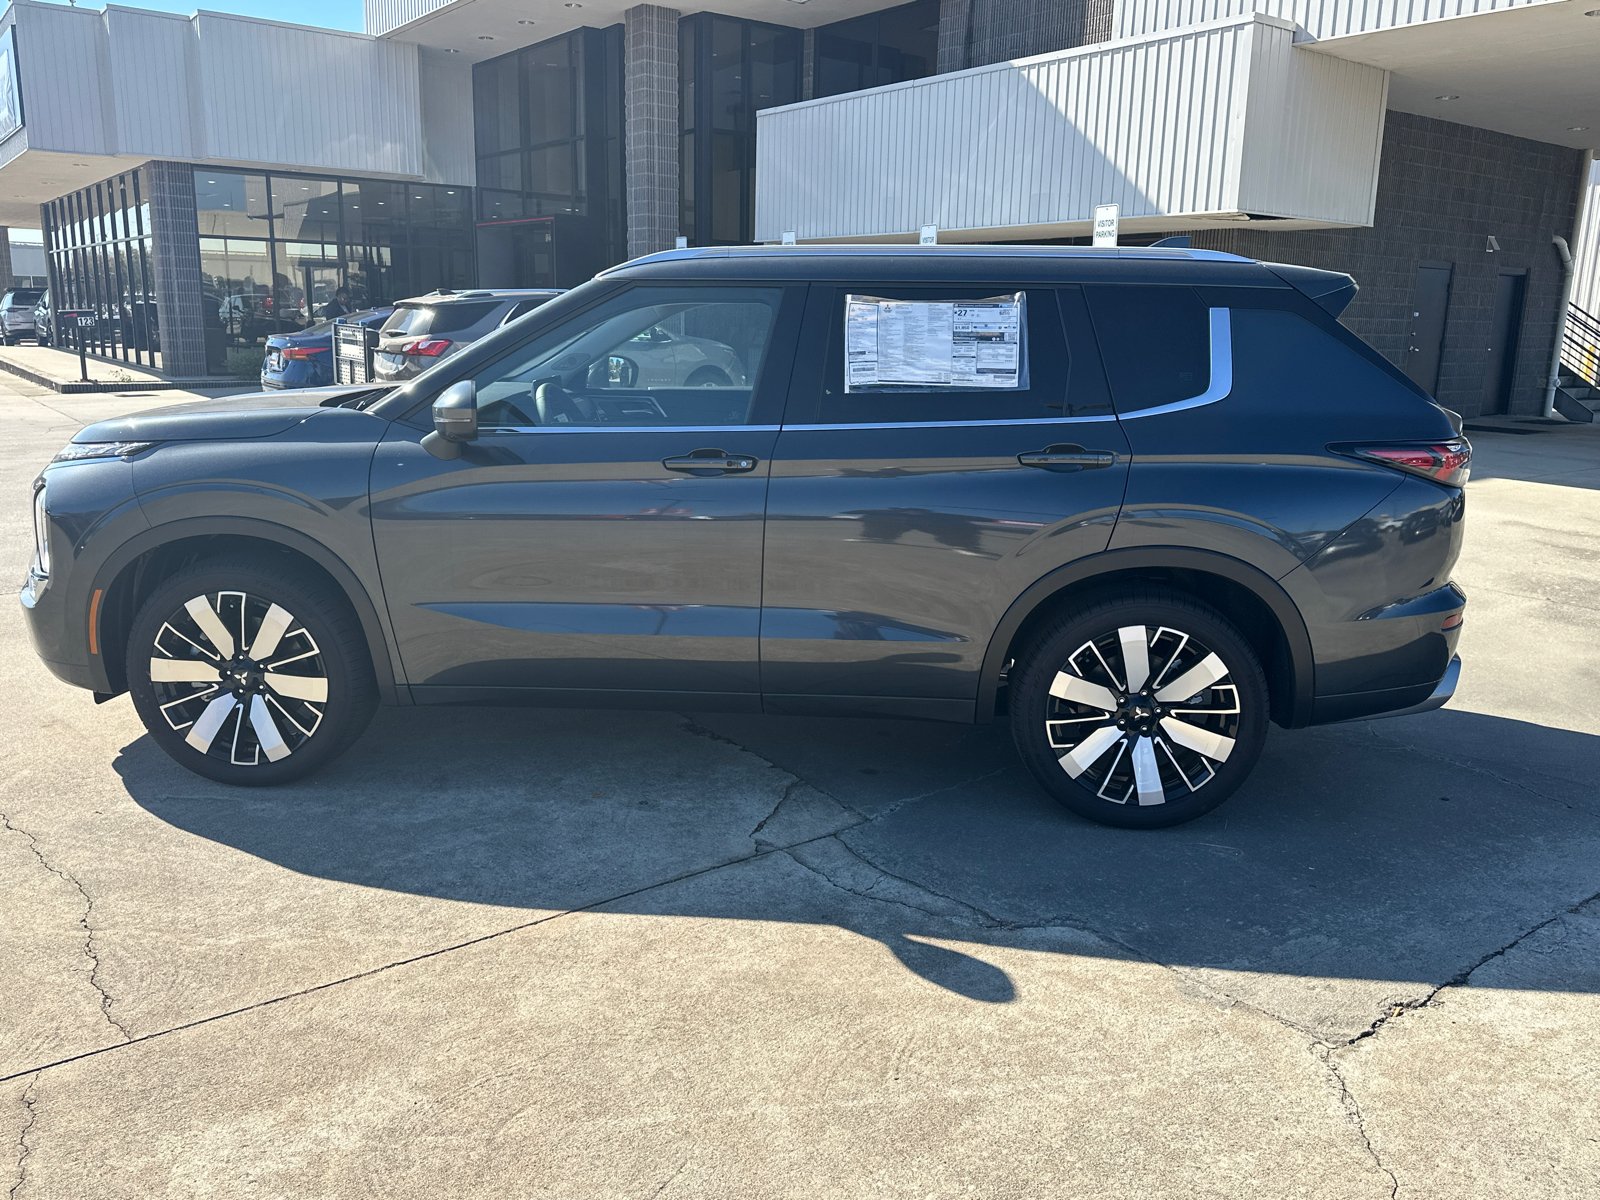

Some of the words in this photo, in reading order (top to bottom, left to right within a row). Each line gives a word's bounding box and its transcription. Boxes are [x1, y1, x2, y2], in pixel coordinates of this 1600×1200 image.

[1097, 219, 1115, 228] VISITOR
[1095, 230, 1115, 239] PARKING
[78, 318, 94, 326] 123
